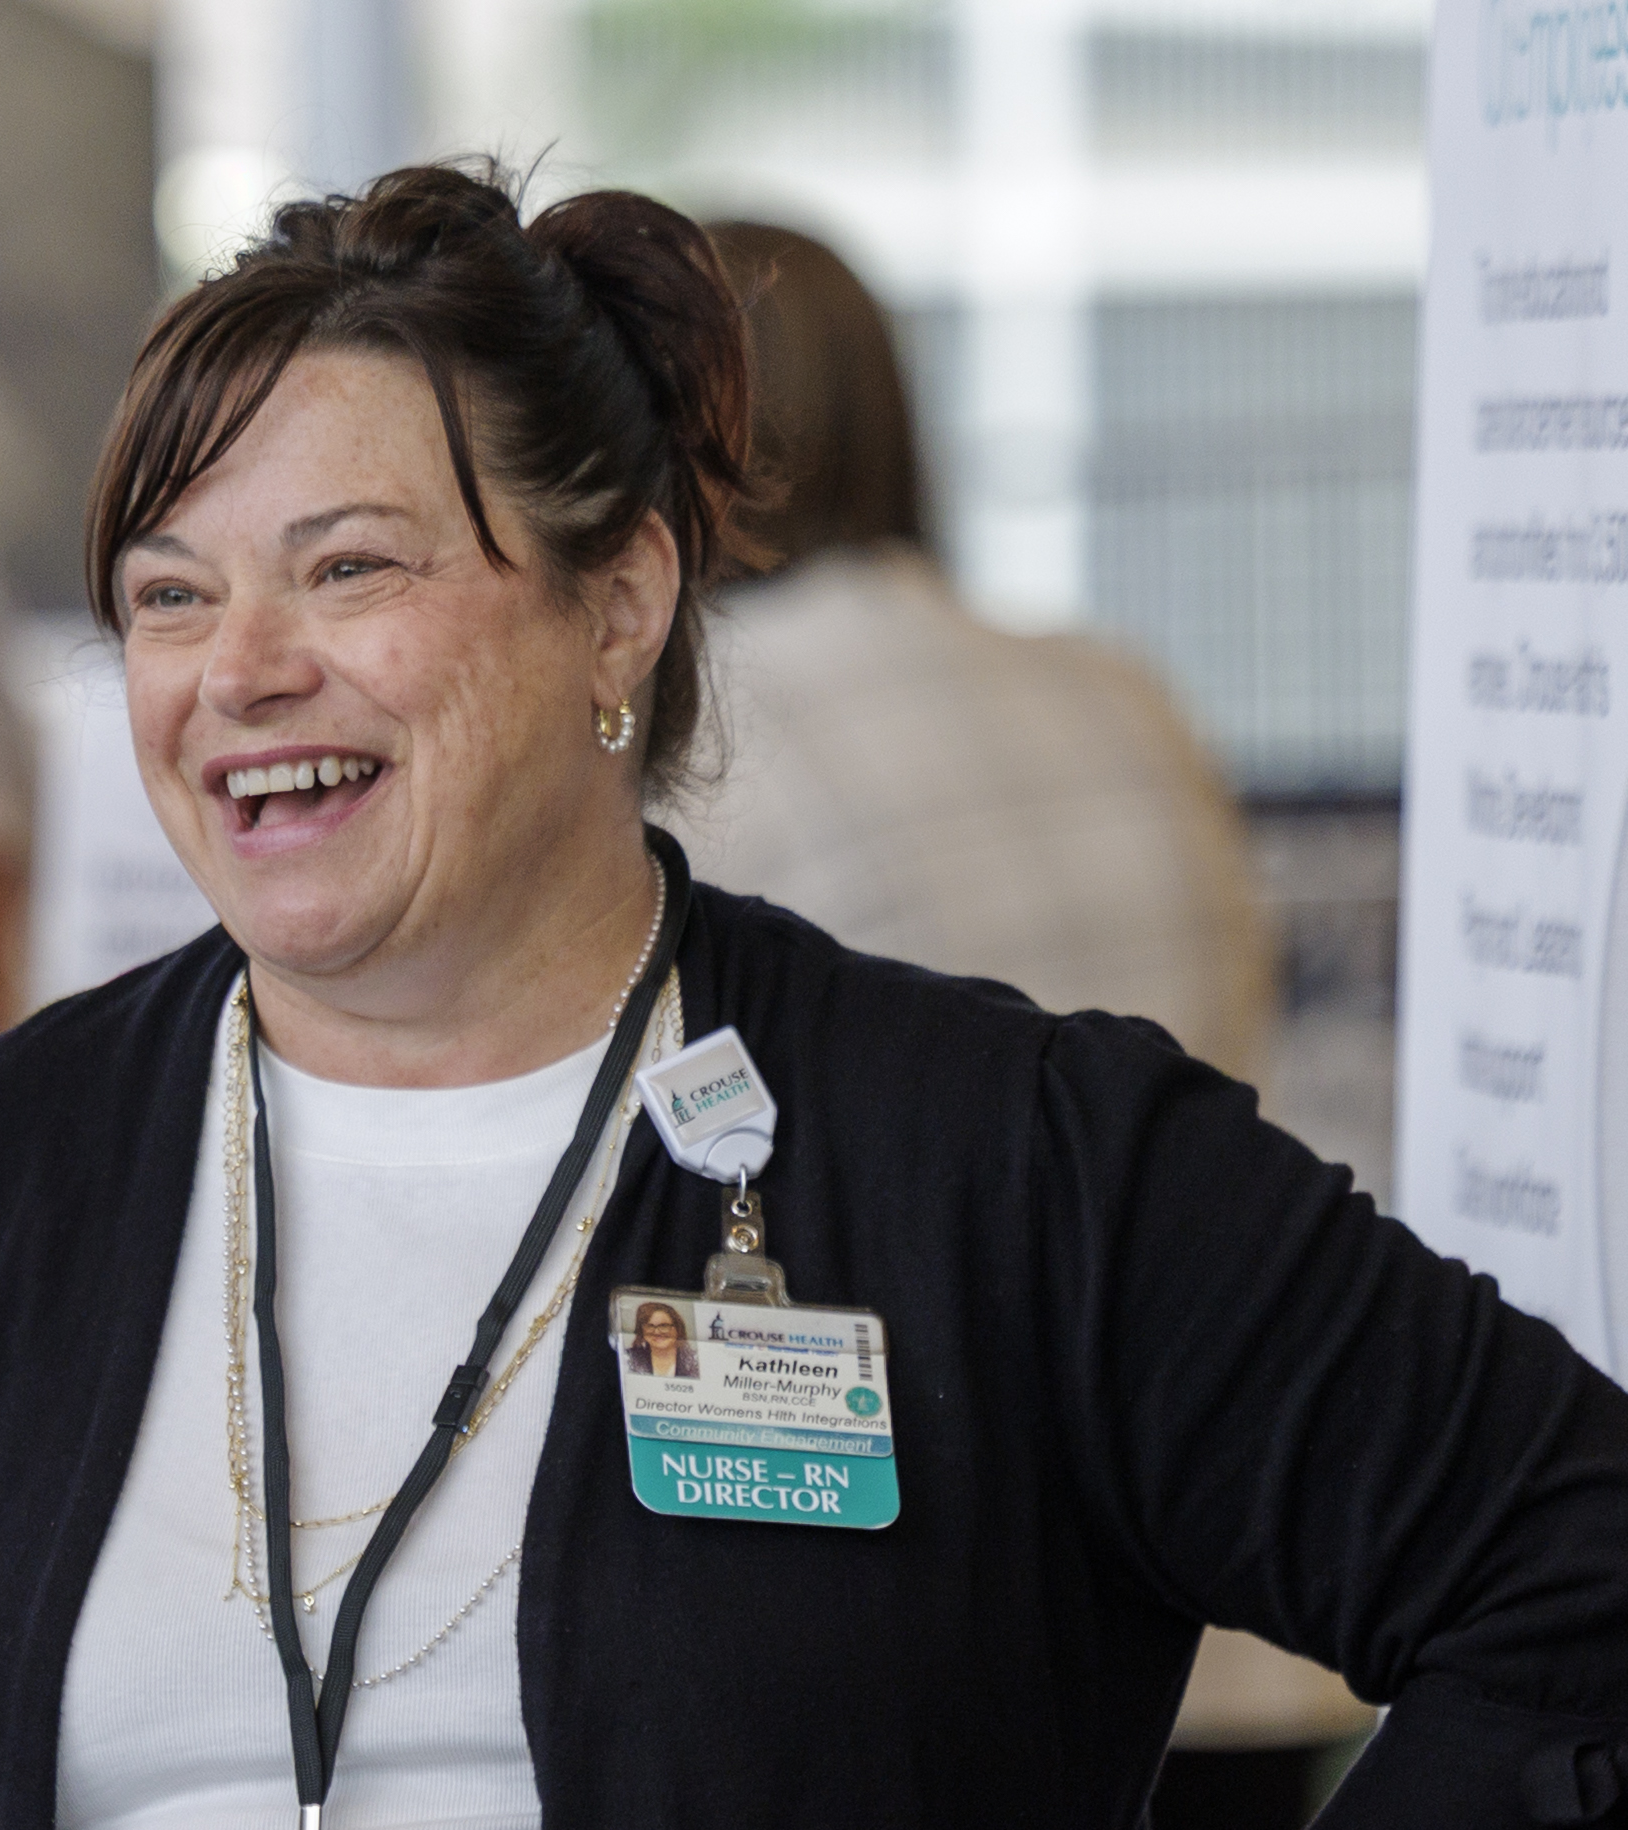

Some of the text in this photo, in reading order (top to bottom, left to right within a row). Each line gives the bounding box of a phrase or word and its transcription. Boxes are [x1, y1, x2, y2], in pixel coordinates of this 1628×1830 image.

[690, 1067, 749, 1102] CROUSE
[695, 1080, 751, 1113] HEALTH
[728, 1328, 844, 1348] CROUSE HEALTH
[738, 1356, 839, 1379] Kathleen
[723, 1374, 842, 1400] Miller-Murphy
[635, 1397, 694, 1414] Director
[698, 1402, 763, 1420] Womens
[801, 1412, 887, 1431] Integrations
[656, 1420, 873, 1455] Community Engagement
[661, 1453, 769, 1483] NURSE
[803, 1462, 849, 1489] RN
[676, 1479, 842, 1515] DIRECTOR
